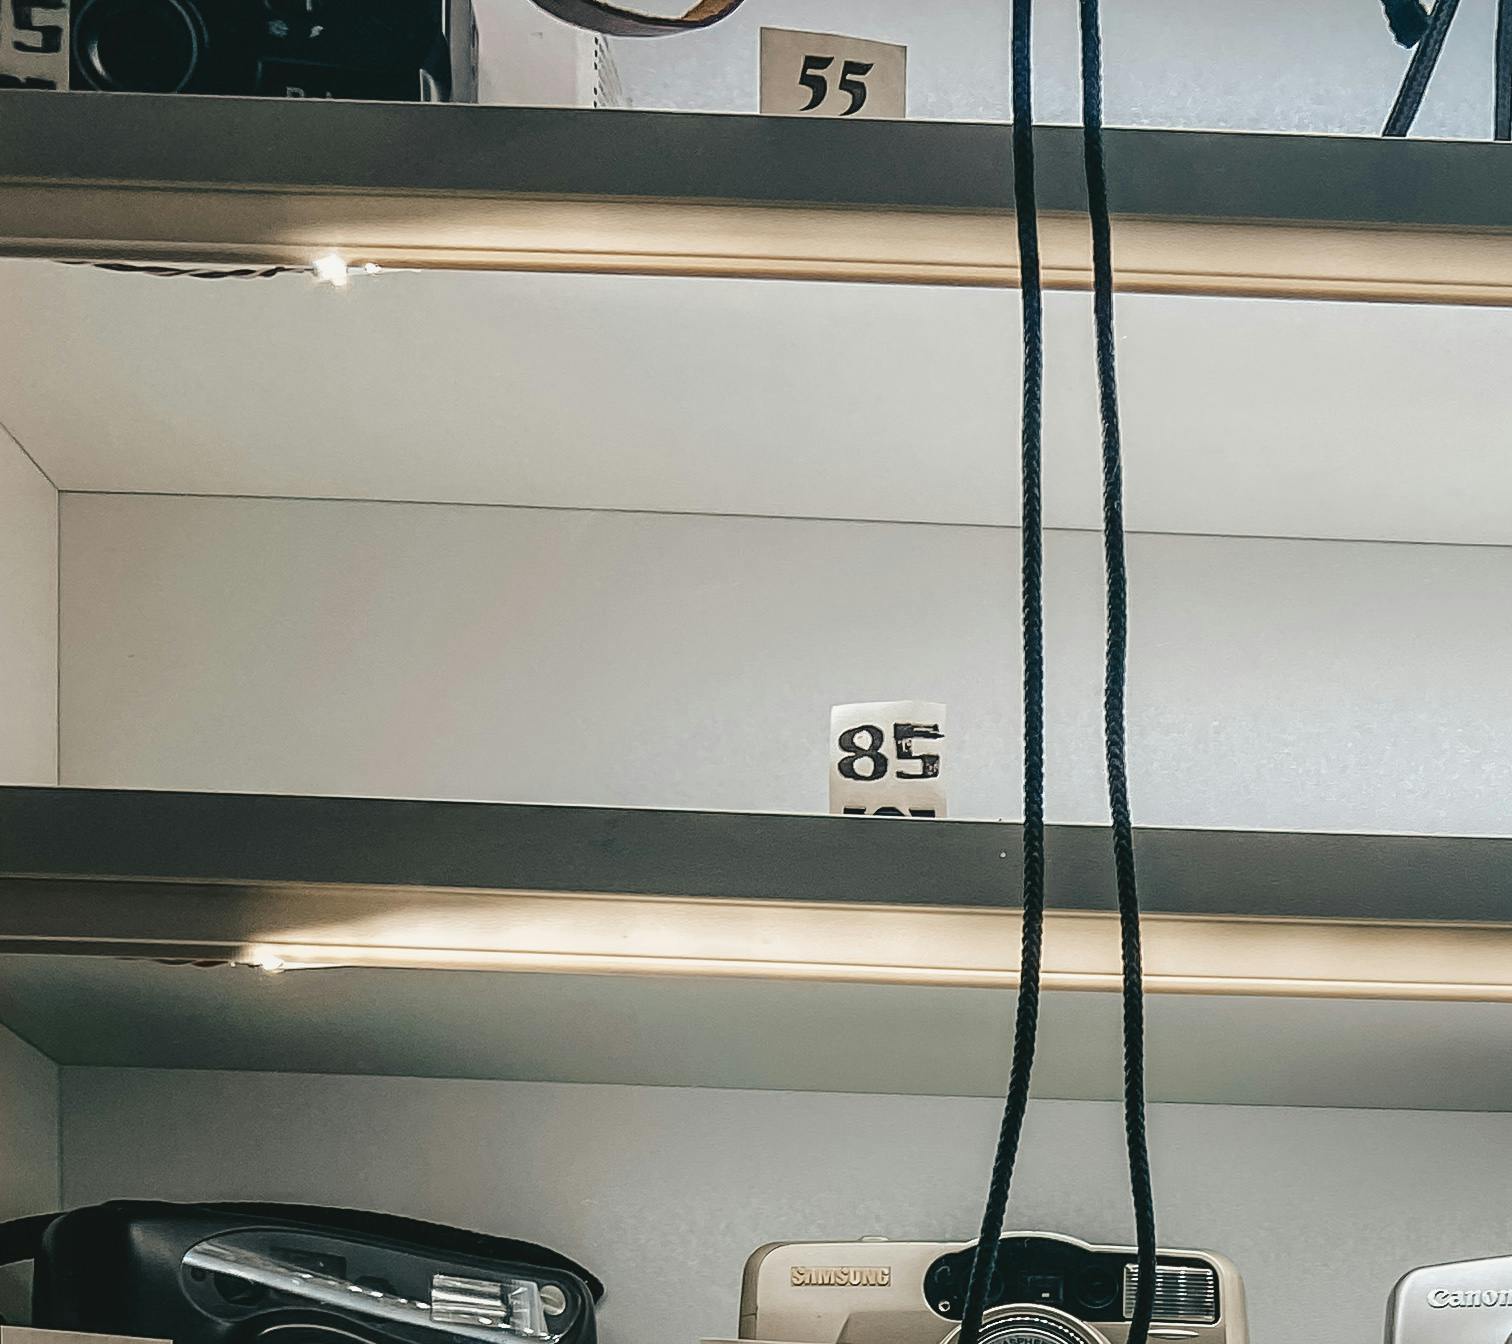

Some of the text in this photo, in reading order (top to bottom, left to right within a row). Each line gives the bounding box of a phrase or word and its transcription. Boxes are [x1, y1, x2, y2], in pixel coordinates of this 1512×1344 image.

[797, 54, 875, 117] 55
[837, 722, 946, 782] 85
[790, 1265, 891, 1288] SAMSUNG
